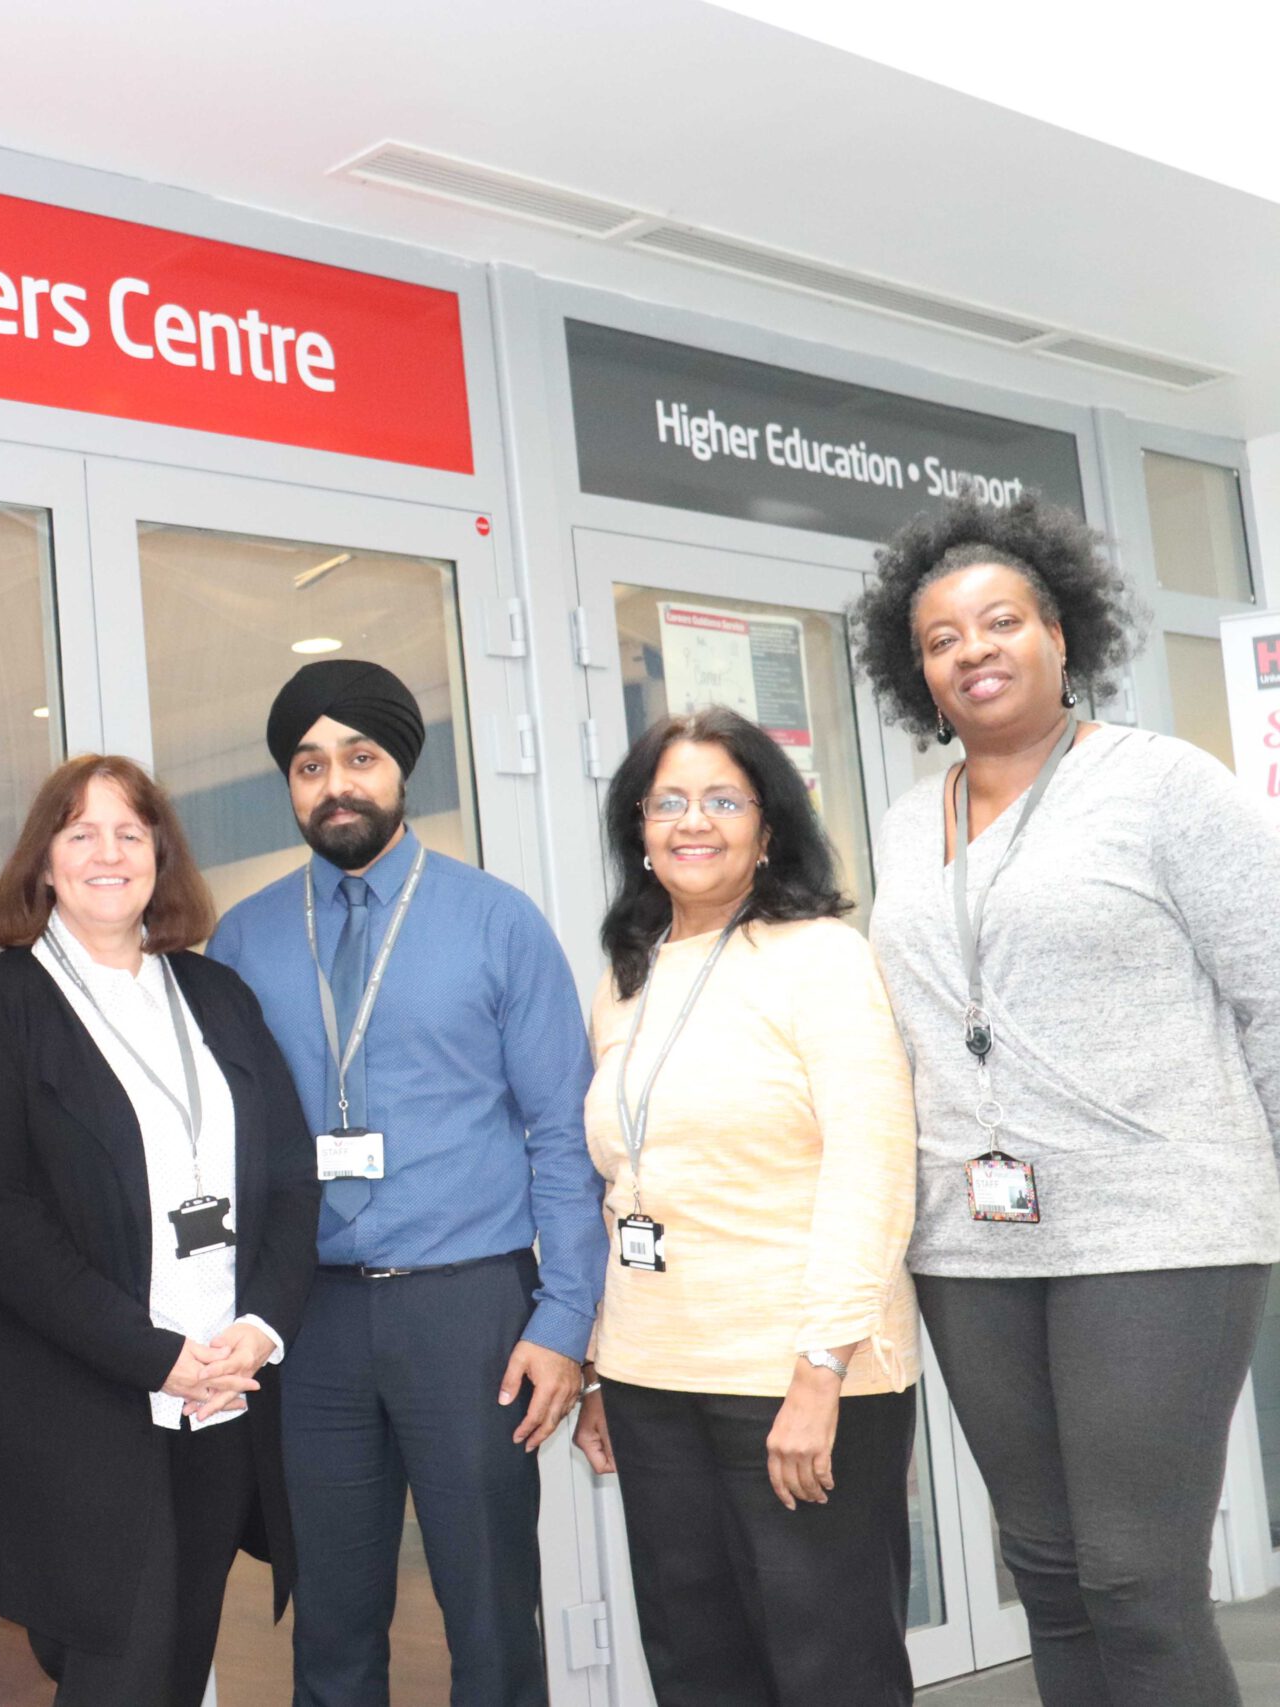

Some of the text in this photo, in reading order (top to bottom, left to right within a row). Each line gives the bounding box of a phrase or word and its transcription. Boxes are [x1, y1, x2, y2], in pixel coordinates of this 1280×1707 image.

[108, 276, 336, 393] Centre
[655, 399, 760, 462] Higher
[765, 422, 904, 490] Education
